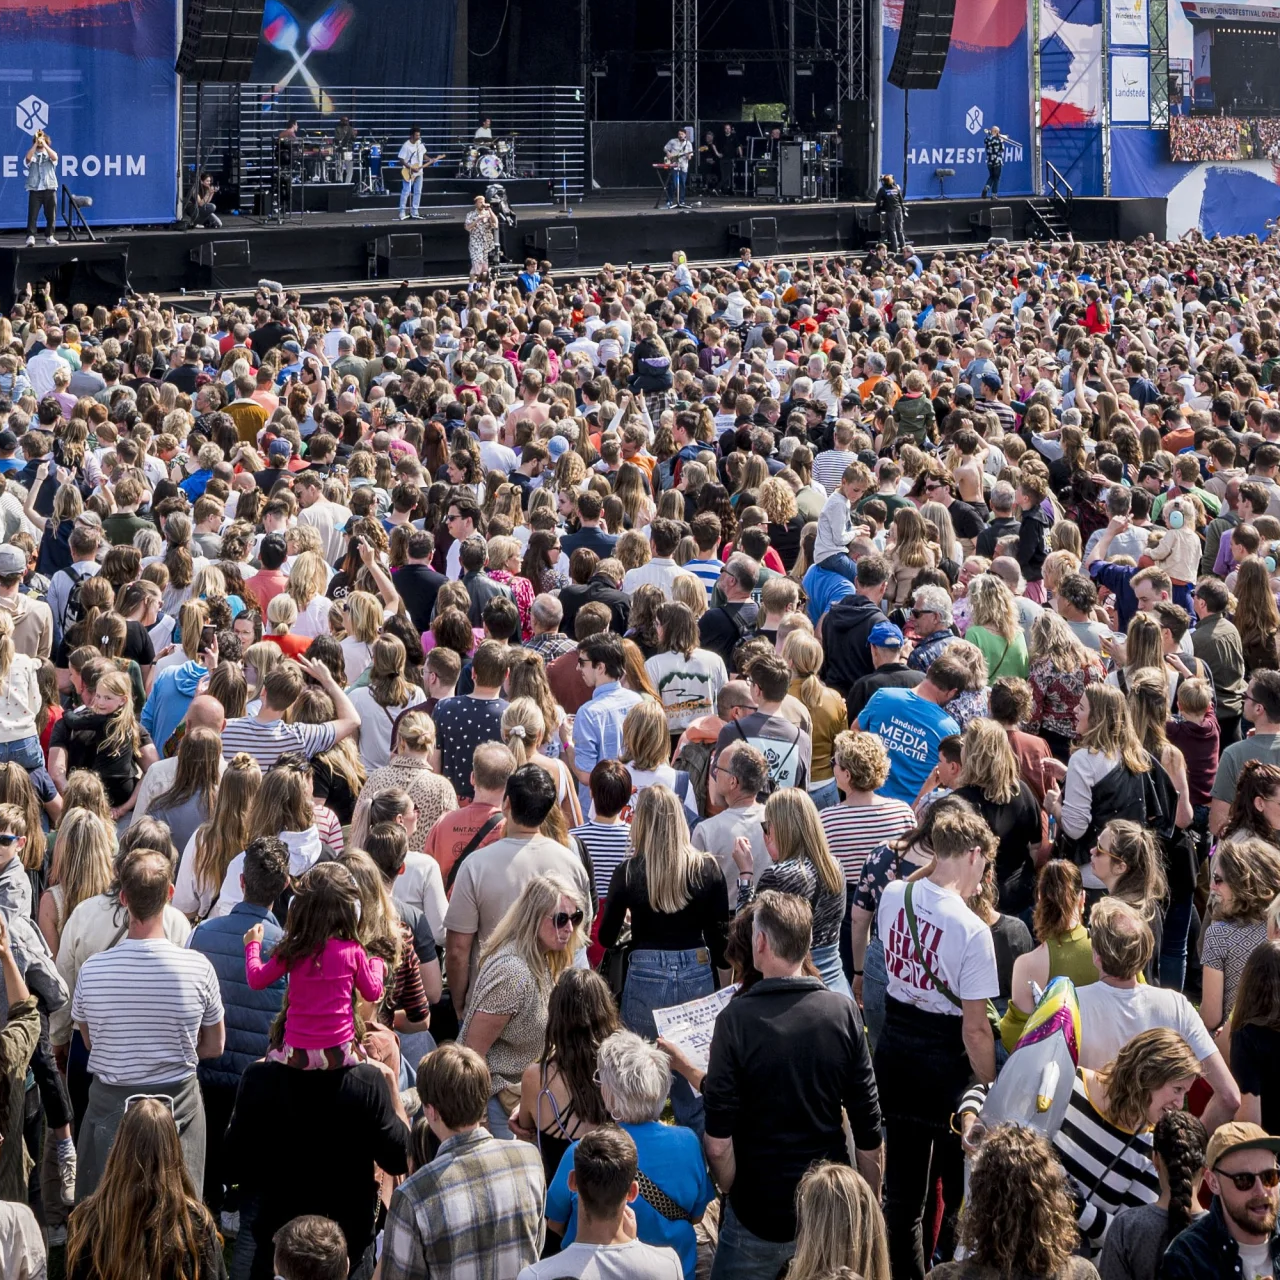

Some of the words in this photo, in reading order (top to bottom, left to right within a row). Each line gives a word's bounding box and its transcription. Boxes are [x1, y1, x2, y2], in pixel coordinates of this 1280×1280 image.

[1114, 87, 1146, 97] Landstede
[906, 147, 1023, 165] HANZESTHM
[890, 715, 926, 738] Landstede
[879, 722, 929, 753] MEDIA
